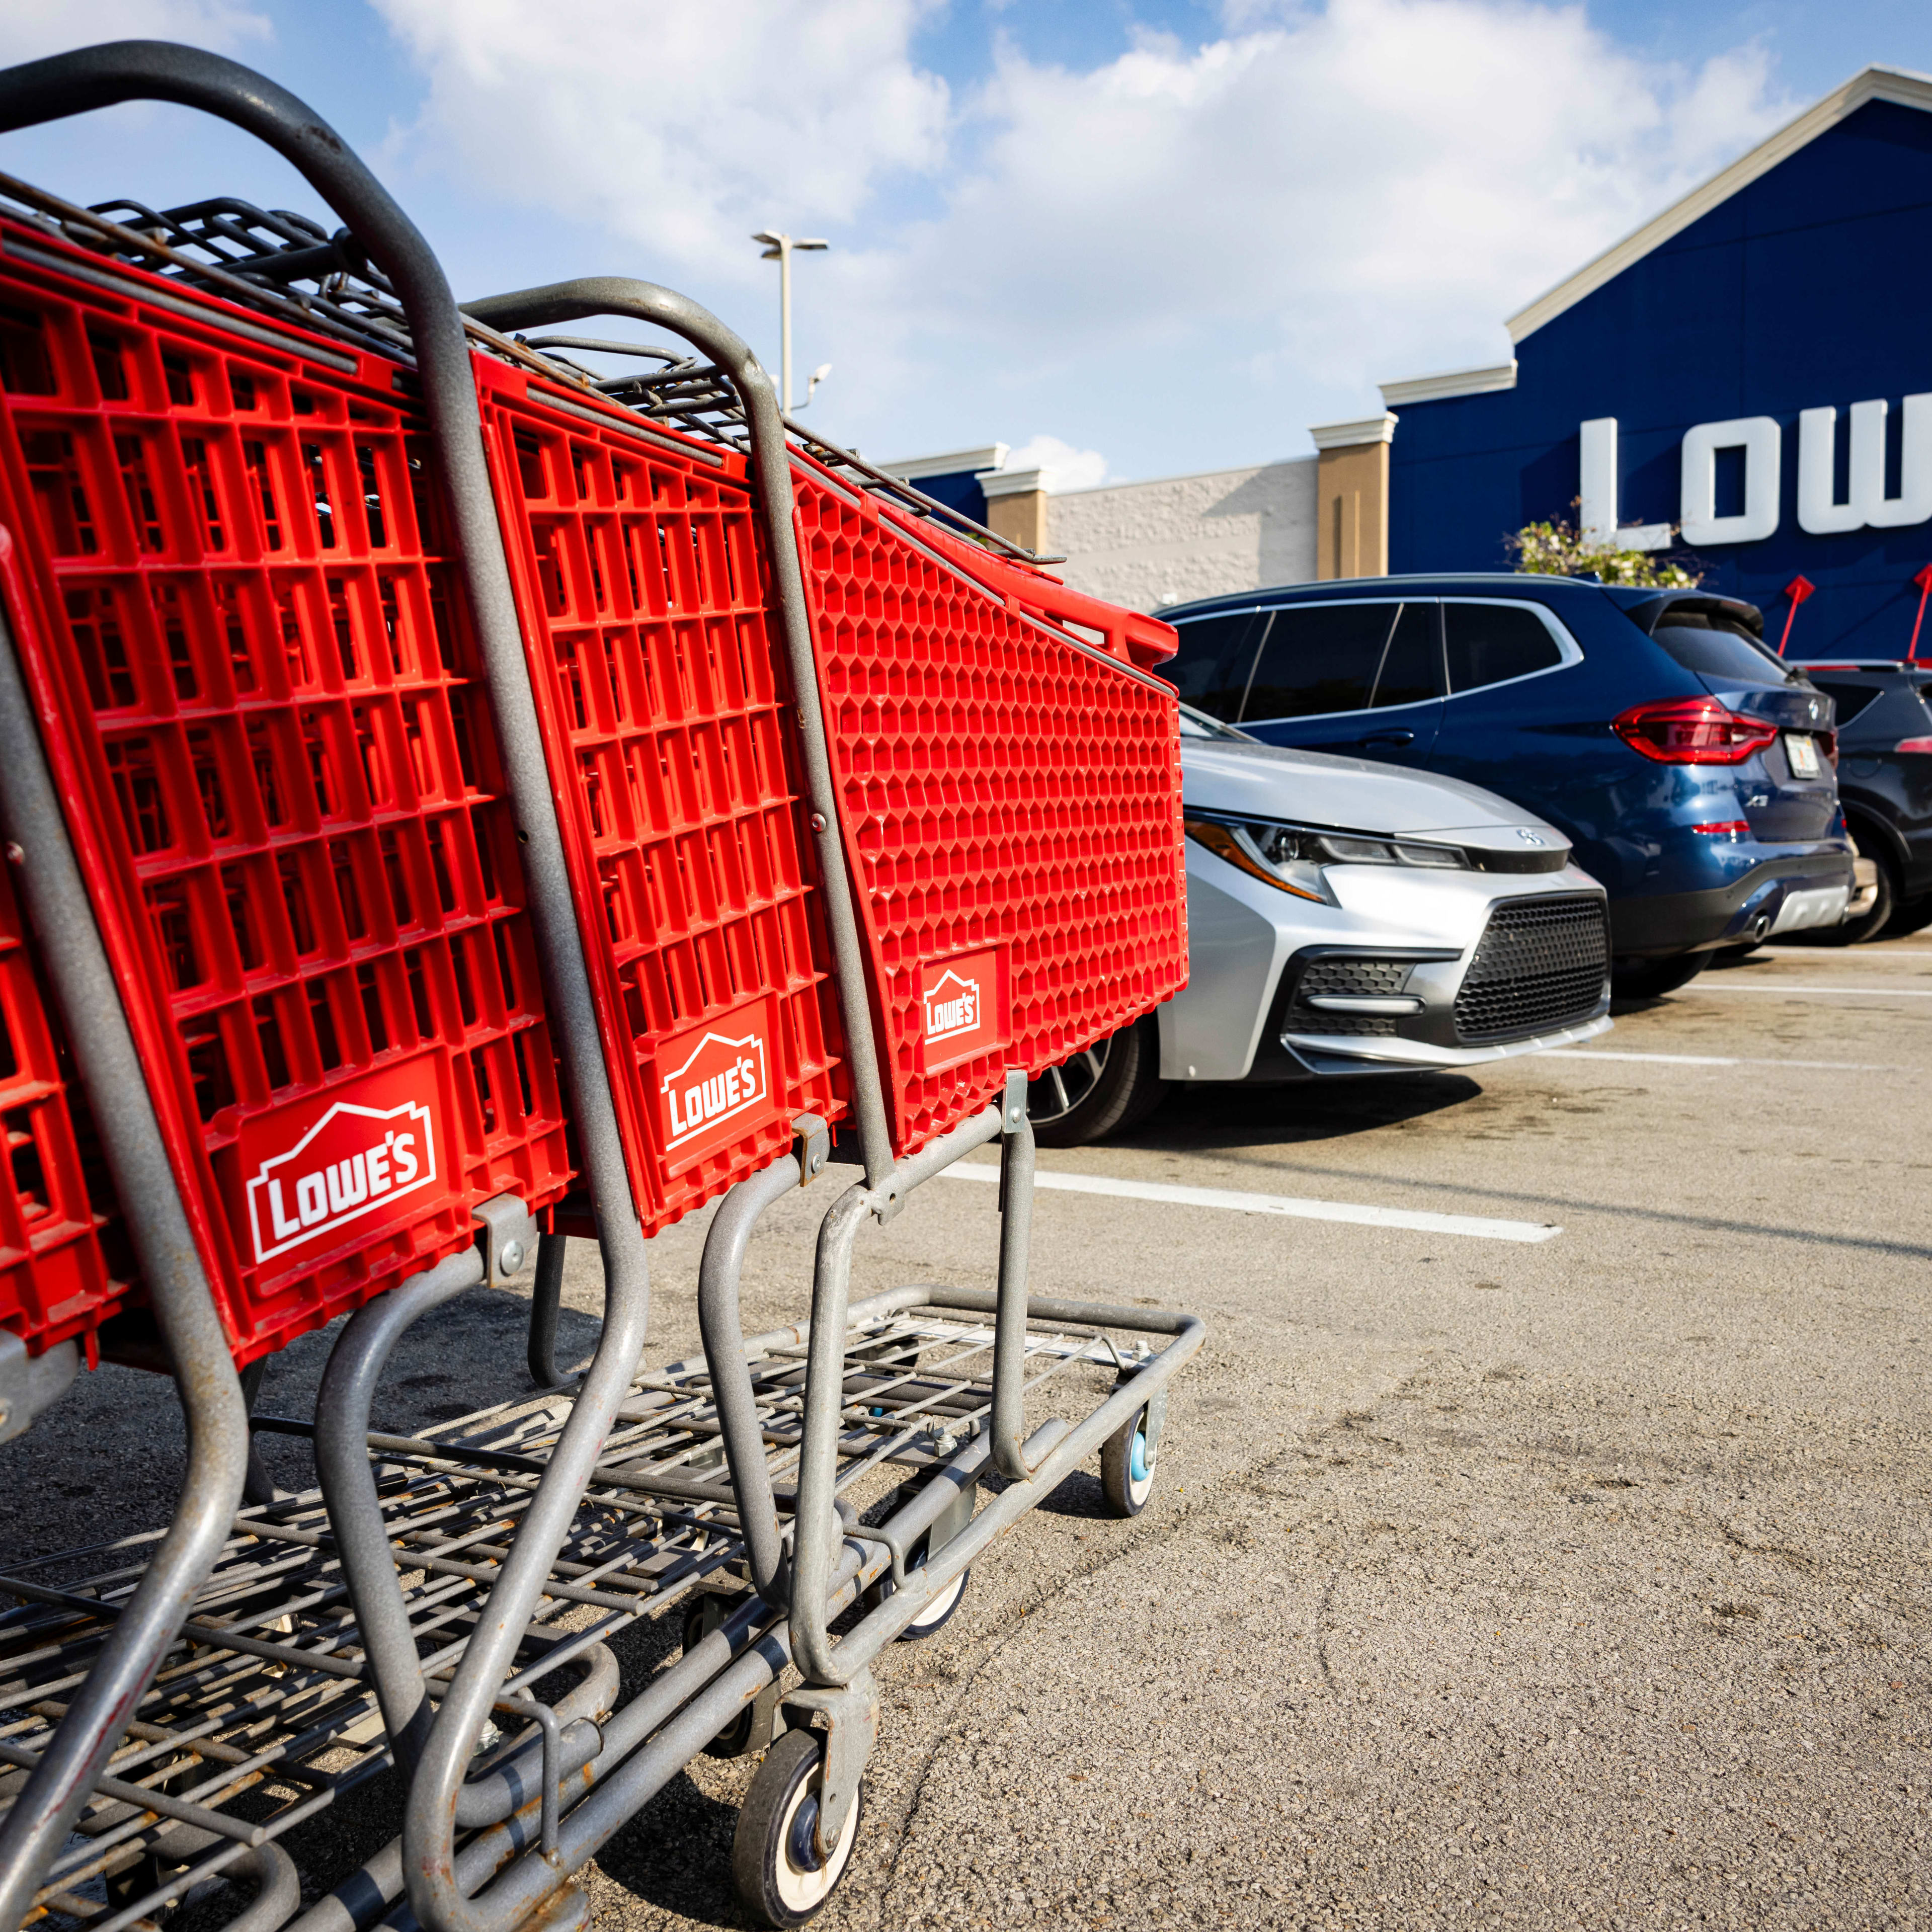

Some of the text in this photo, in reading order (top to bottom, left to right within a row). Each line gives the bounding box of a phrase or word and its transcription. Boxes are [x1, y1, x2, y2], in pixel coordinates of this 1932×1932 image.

[926, 992, 975, 1035] LOWE'S
[669, 1056, 756, 1137] LOWE'S
[268, 1130, 418, 1240] LOWE'S
